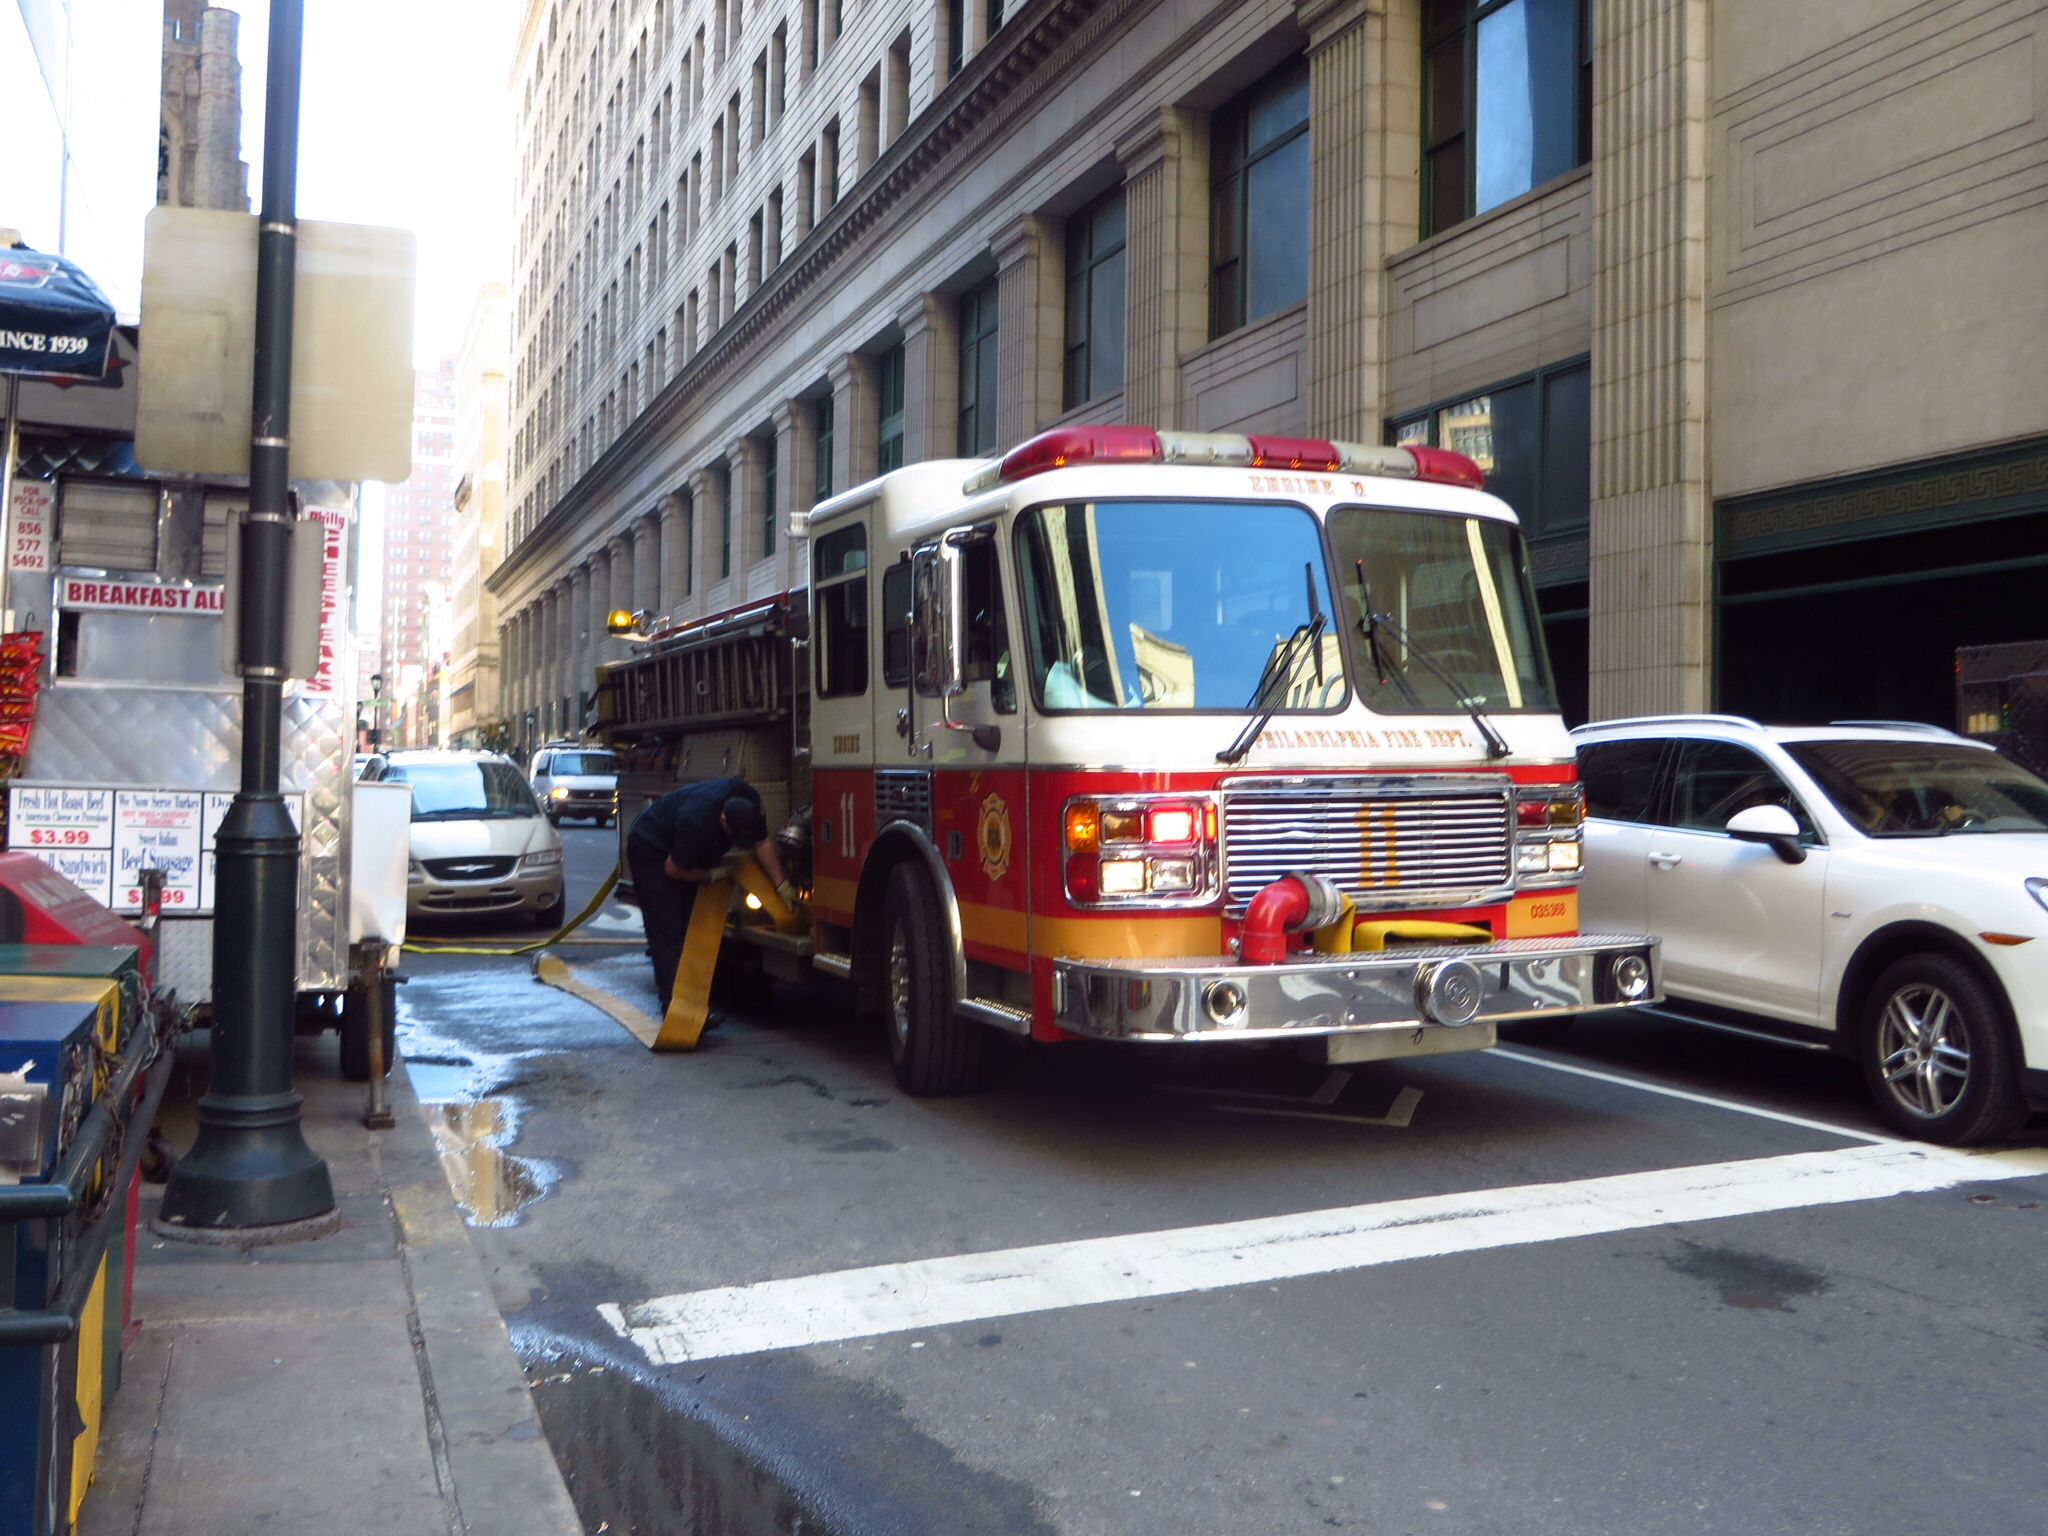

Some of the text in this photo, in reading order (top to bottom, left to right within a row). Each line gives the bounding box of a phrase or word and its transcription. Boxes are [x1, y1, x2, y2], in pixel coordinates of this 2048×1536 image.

[49, 336, 88, 354] 1939
[18, 522, 42, 535] 856
[17, 540, 41, 552] 577
[12, 554, 44, 568] 5492
[68, 582, 190, 608] BREAKFAST
[840, 792, 855, 858] 11
[30, 829, 89, 845] $3.99
[1354, 803, 1400, 888] 11
